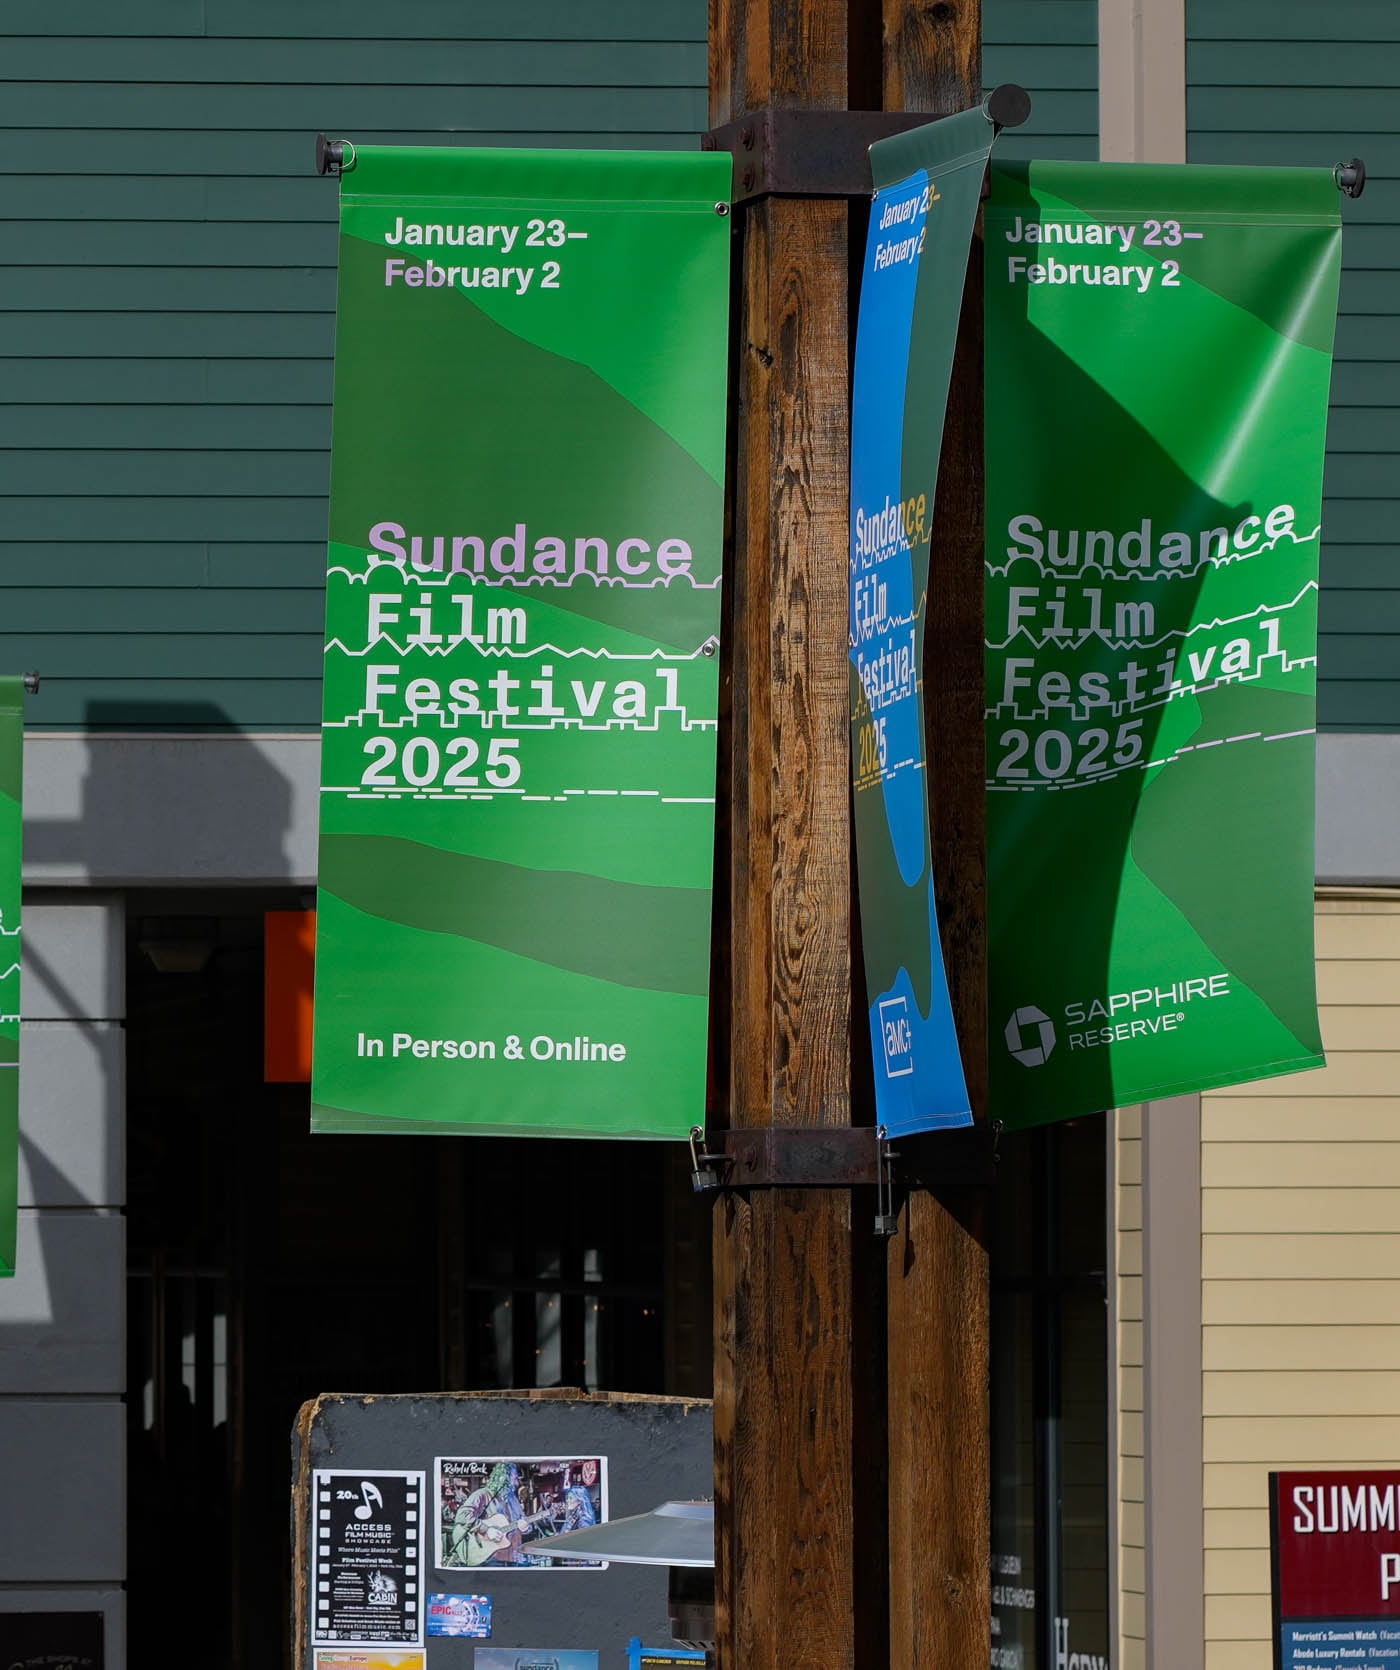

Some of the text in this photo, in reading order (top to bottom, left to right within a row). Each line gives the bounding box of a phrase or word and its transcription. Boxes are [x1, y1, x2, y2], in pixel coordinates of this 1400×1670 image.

[385, 217, 519, 253] January
[880, 196, 920, 230] January
[1006, 216, 1136, 252] January
[874, 226, 926, 272] February 2
[1008, 256, 1180, 293] February 2
[385, 259, 560, 295] February 2
[367, 522, 693, 575] Sundance
[856, 494, 925, 555] Sundance
[1006, 504, 1296, 569] Sundance
[367, 592, 527, 645] Film
[855, 573, 887, 631] Film
[1007, 586, 1155, 638] Film
[858, 629, 916, 704] Festival
[1003, 618, 1280, 707] Festival
[365, 665, 678, 718] Festival
[360, 736, 521, 787] 2025
[859, 717, 887, 777] 2025
[996, 719, 1144, 778] 2025
[1064, 973, 1230, 1026] SAPPHIRE
[357, 1032, 627, 1062] In Person & Online
[336, 1490, 359, 1500] 20th
[345, 1523, 392, 1532] ACCESS
[368, 1592, 398, 1604] CABIN
[1292, 1631, 1327, 1641] Marriott's
[1328, 1631, 1355, 1640] Summit
[1356, 1630, 1378, 1640] Watch
[1293, 1648, 1398, 1660] Abode Luxury Rentals (Vacation
